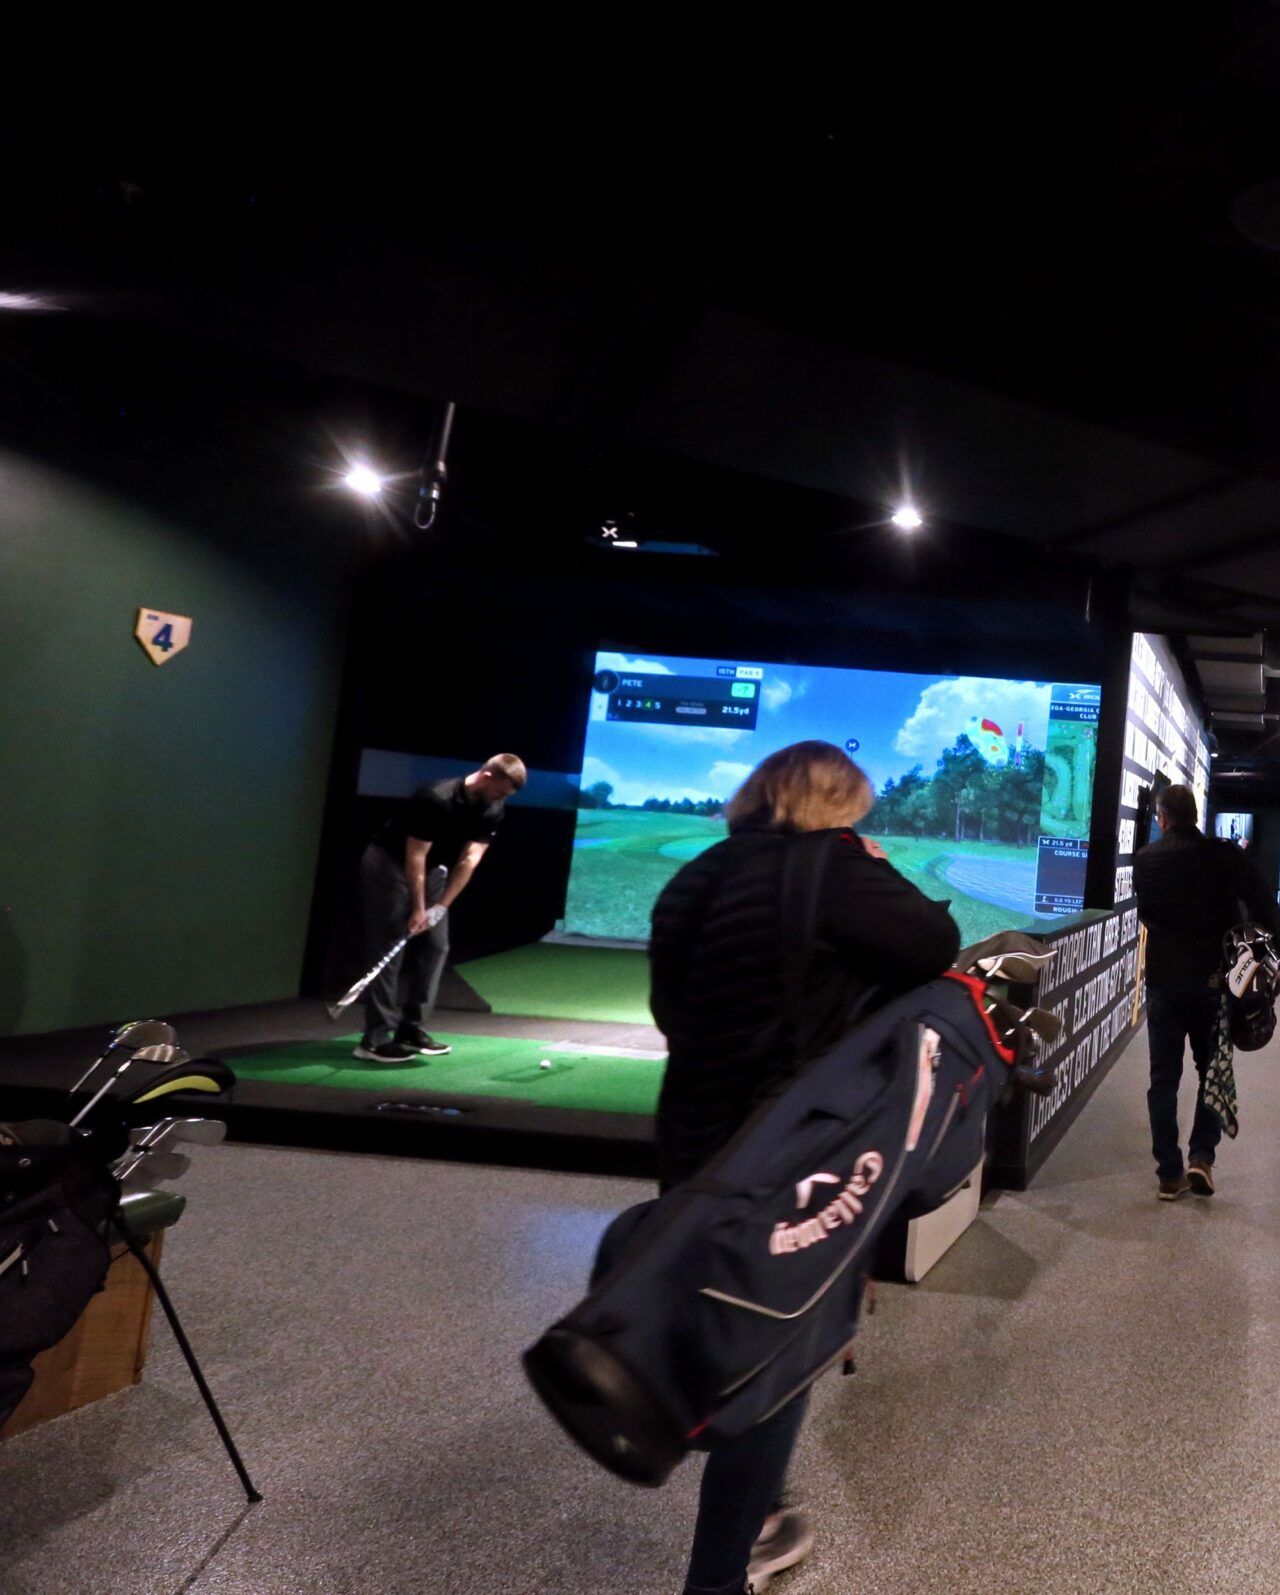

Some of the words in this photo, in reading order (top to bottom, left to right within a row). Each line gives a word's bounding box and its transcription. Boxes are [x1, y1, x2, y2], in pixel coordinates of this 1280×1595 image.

[152, 623, 173, 652] 4
[622, 679, 643, 688] PETE
[626, 699, 632, 707] 2
[635, 700, 642, 708] 3
[655, 701, 661, 709] 5
[1054, 850, 1080, 858] COURSE
[1053, 906, 1077, 914] ROUGH
[1041, 921, 1103, 997] METROPOLITAN
[1074, 1032, 1092, 1088] CITY
